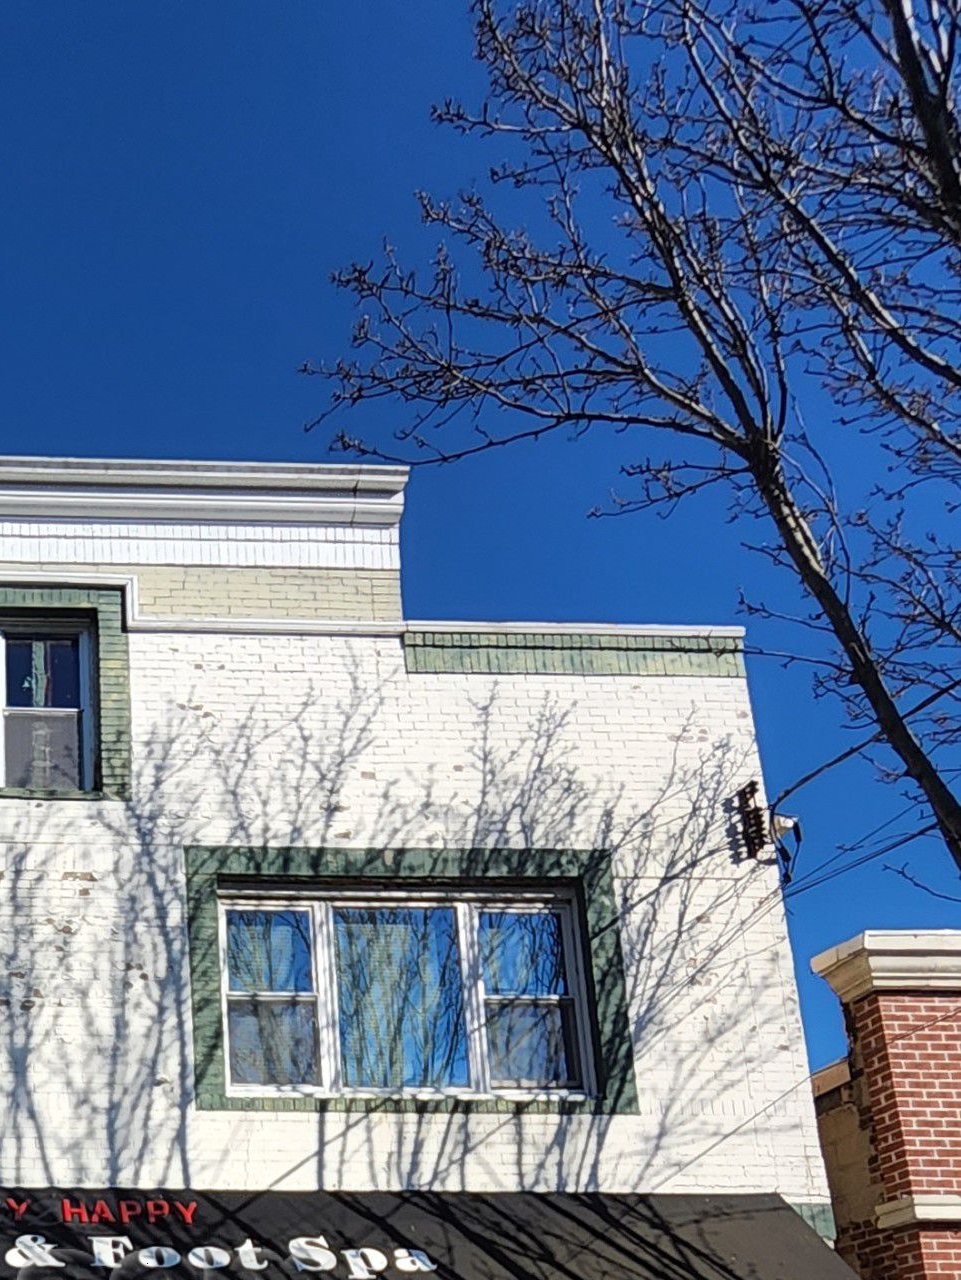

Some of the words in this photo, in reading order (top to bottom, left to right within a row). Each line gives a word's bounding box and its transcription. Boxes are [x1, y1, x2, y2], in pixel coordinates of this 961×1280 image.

[61, 1198, 198, 1225] HAPPY
[5, 1233, 65, 1268] &
[88, 1234, 269, 1271] Foot
[287, 1233, 437, 1280] Spa
